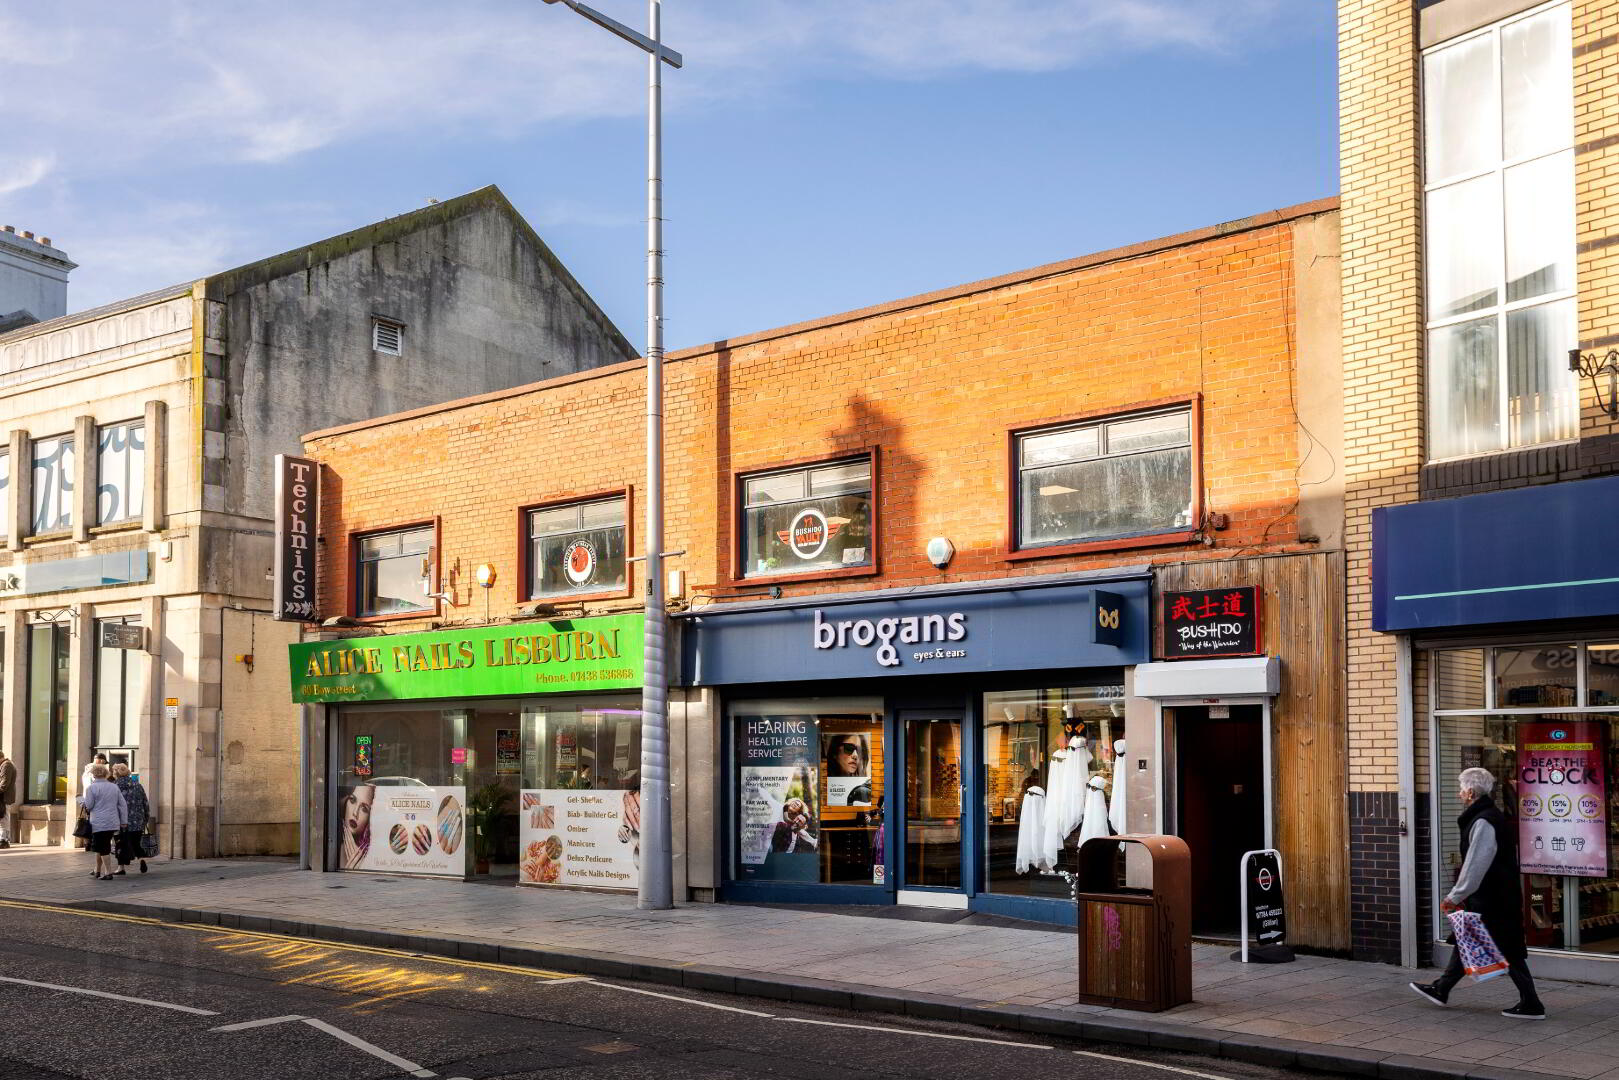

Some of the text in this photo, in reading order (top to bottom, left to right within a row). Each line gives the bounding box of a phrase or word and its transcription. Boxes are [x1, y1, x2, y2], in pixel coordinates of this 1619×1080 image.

[290, 462, 310, 599] Technics
[795, 526, 822, 536] BUSHIDO
[1171, 592, 1248, 621] 武士道
[1177, 622, 1242, 640] BUSHIDO
[814, 609, 966, 667] brogans
[1196, 641, 1203, 650] of
[306, 628, 621, 677] ALICE NAILS LISBURN
[913, 648, 965, 662] eyes & ears
[748, 721, 806, 734] HEARING
[748, 737, 808, 746] HEALTH CARE
[748, 749, 783, 758] SERVICE
[1531, 758, 1586, 767] BEAT THE
[1522, 768, 1600, 785] CLOCK
[585, 855, 613, 863] Pedicure
[567, 869, 631, 880] Acrylic Nails Designs
